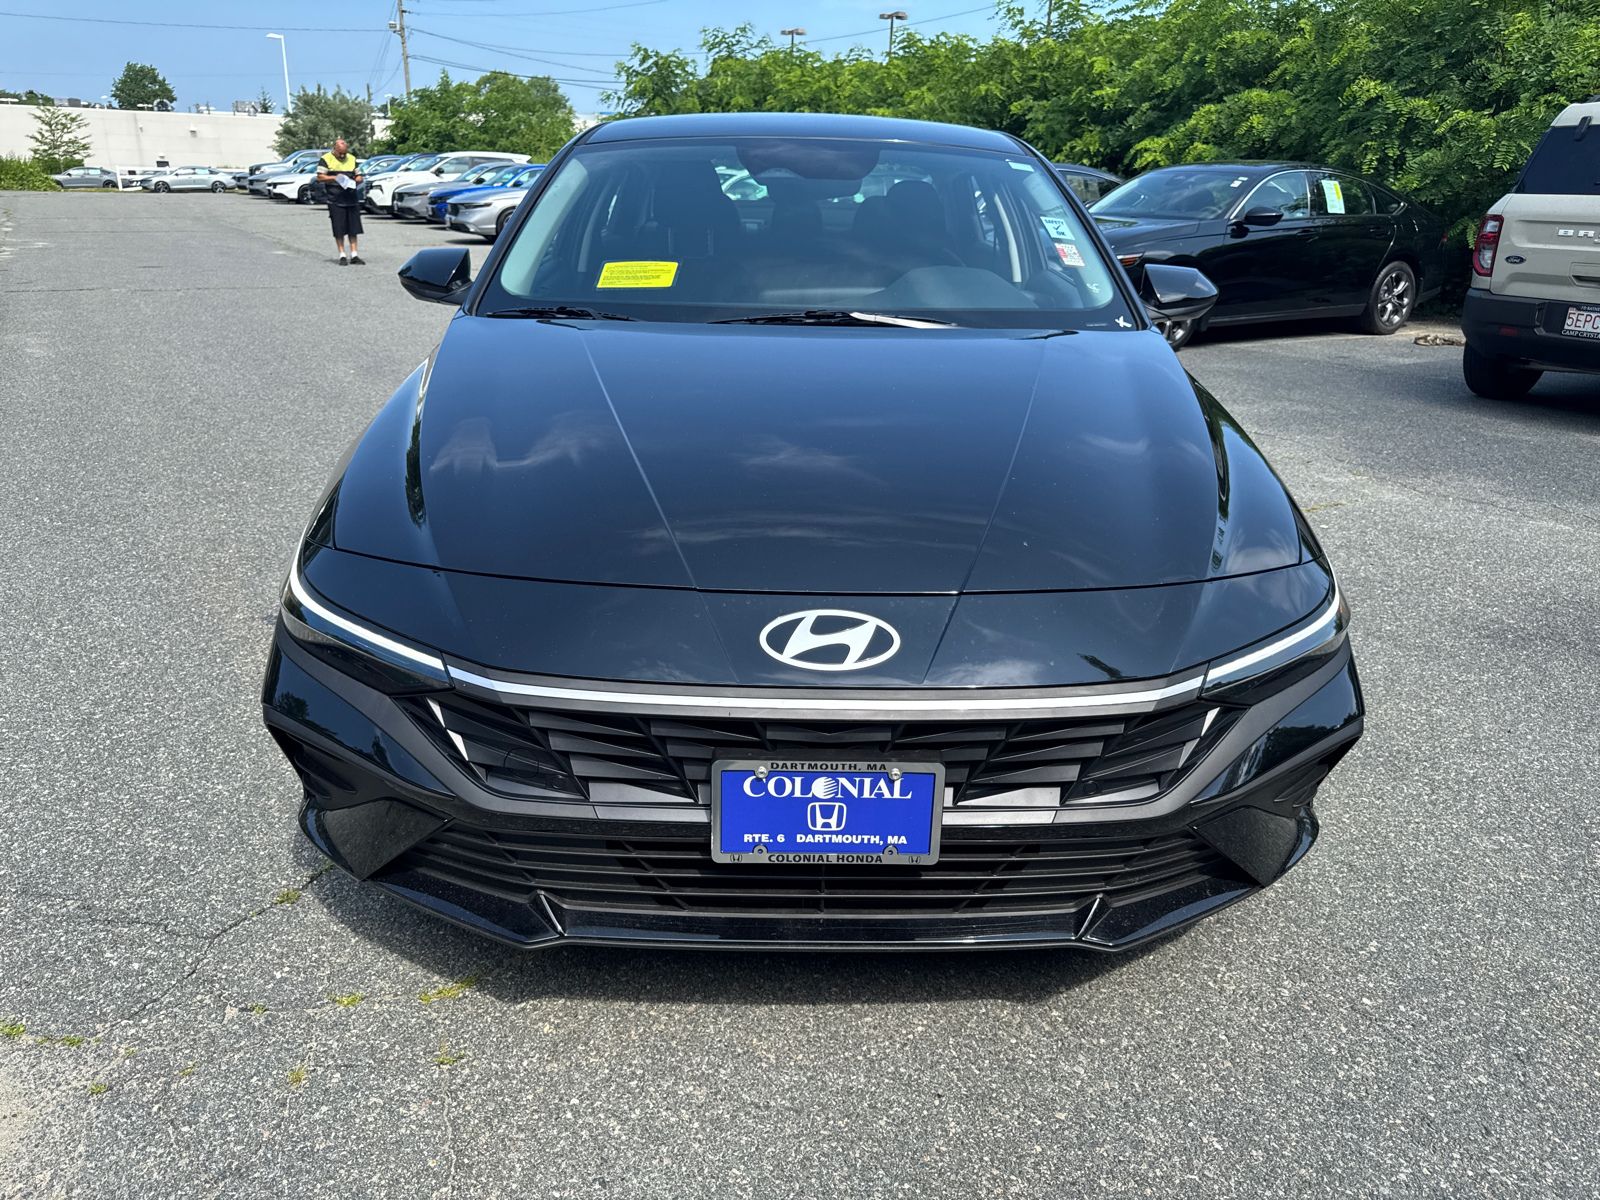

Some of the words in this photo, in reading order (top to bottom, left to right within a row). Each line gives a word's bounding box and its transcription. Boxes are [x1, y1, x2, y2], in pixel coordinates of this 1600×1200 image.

[866, 763, 887, 771] MA
[743, 776, 913, 799] COLONIAL
[743, 833, 773, 843] RTE.
[776, 833, 786, 843] 6
[796, 833, 884, 846] DARTMOUTH,
[887, 835, 908, 845] MA
[767, 854, 833, 863] COLONIAL
[836, 854, 883, 863] HONDA
